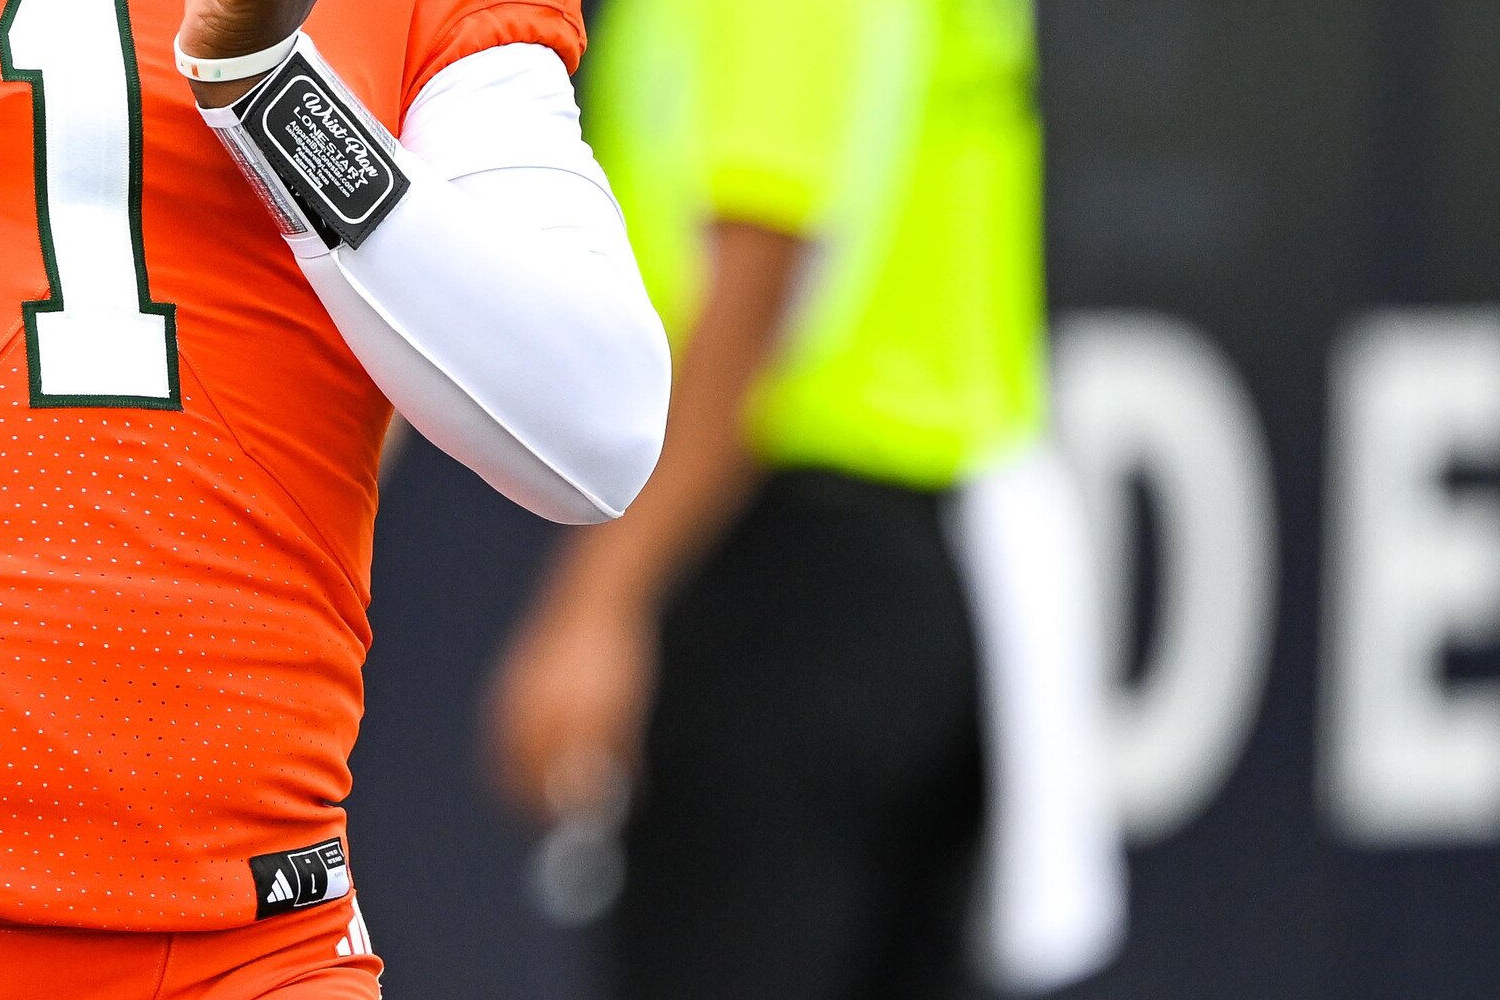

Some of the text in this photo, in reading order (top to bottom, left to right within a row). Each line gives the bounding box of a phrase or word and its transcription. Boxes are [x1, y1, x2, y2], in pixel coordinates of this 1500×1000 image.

[287, 120, 354, 192] ApparelByLonestar.com
[302, 92, 347, 139] Wrist
[344, 136, 378, 176] Plan
[294, 153, 323, 189] Patent Pending
[316, 168, 329, 185] Texas
